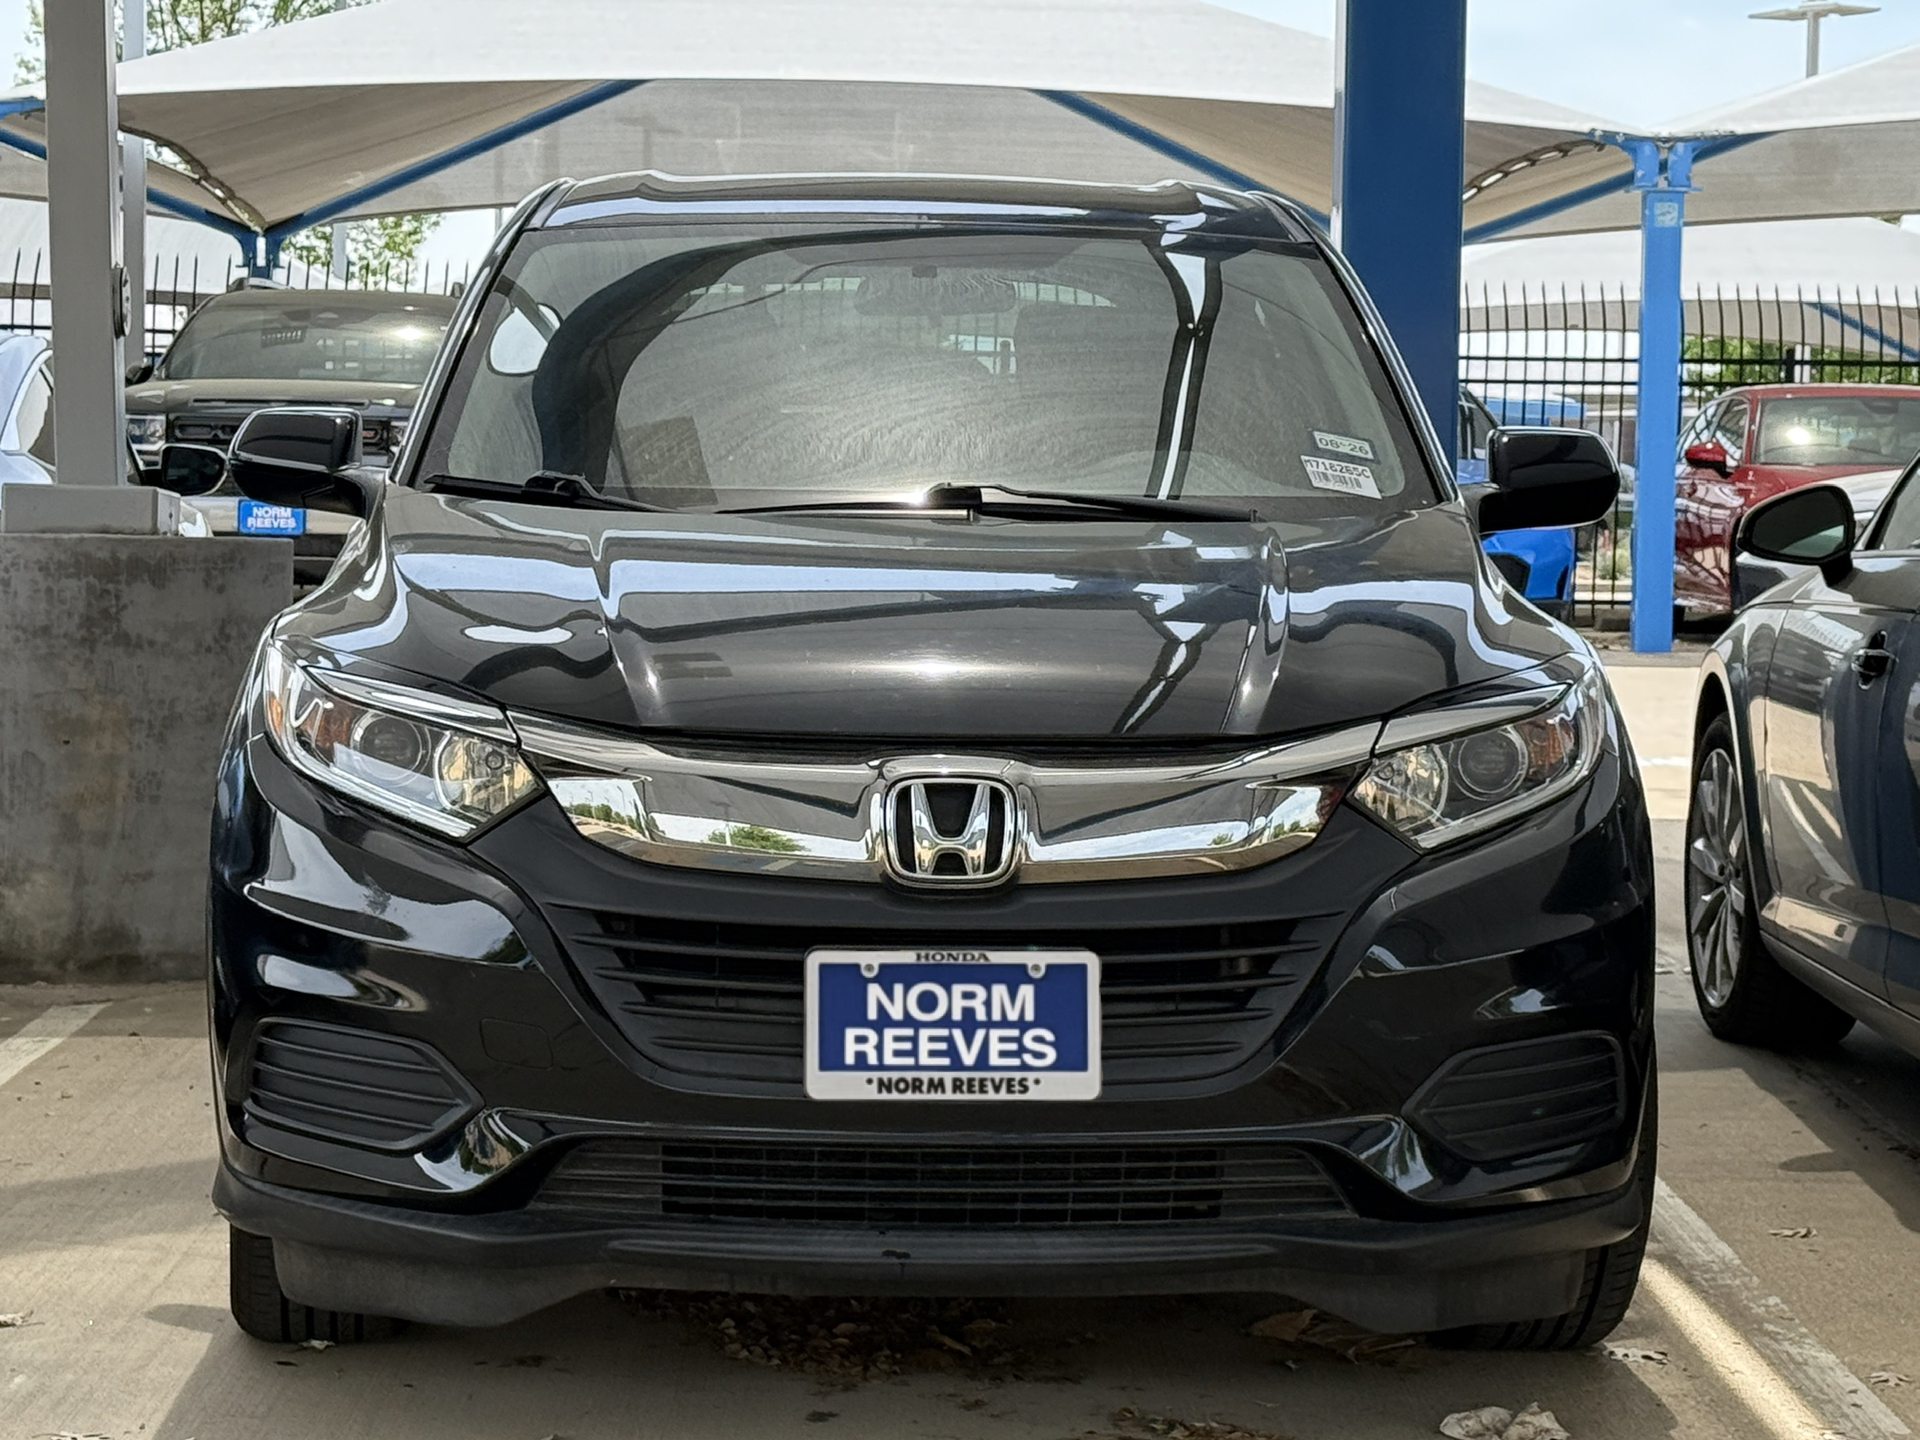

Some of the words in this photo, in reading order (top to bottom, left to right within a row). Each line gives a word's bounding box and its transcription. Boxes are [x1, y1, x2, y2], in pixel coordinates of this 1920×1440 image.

[253, 506, 292, 518] NORM
[246, 517, 297, 529] REEVES
[915, 951, 991, 963] HONDA
[866, 982, 1035, 1022] NORM
[844, 1027, 1057, 1067] REEVES
[877, 1077, 946, 1094] NORM
[952, 1077, 1030, 1094] REEVES
